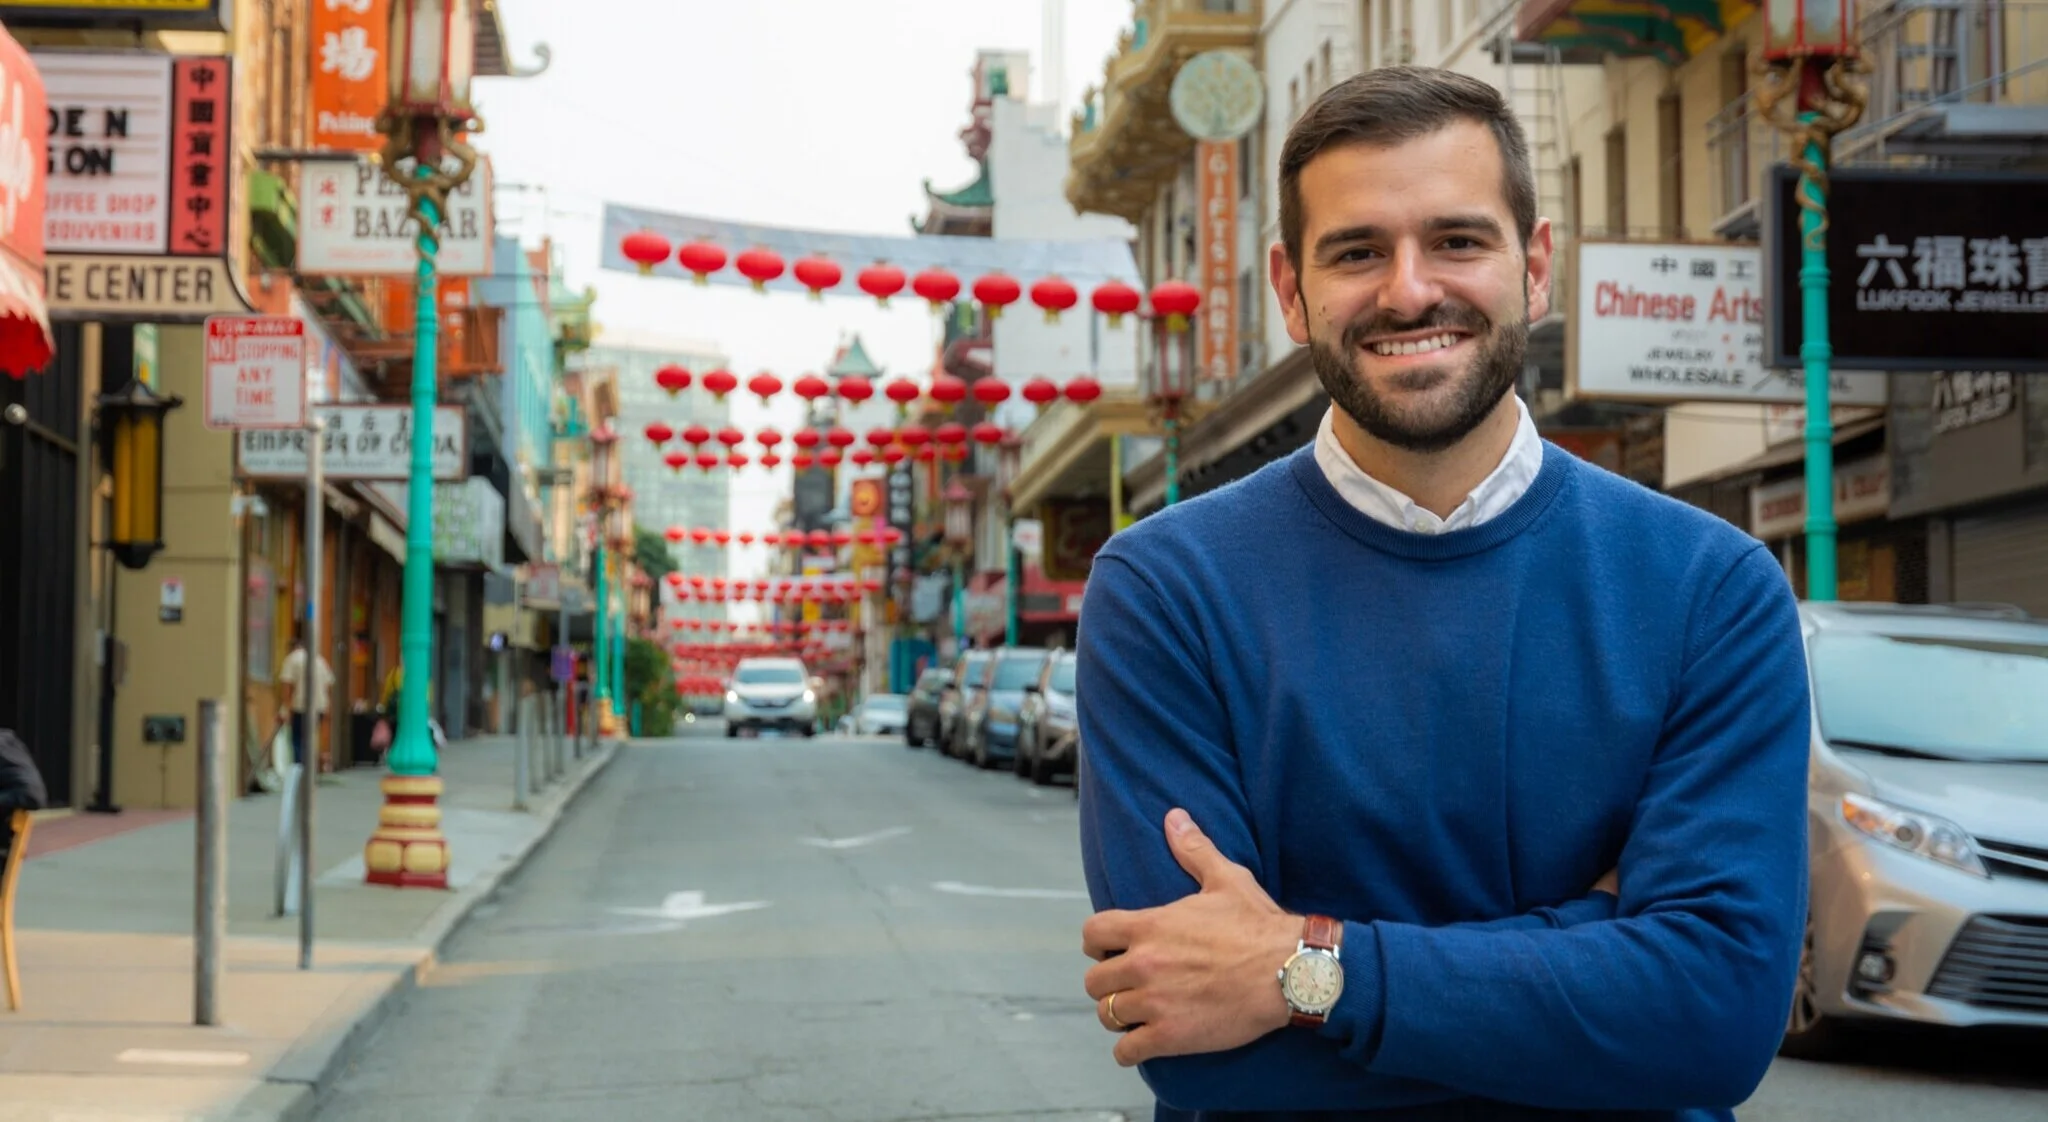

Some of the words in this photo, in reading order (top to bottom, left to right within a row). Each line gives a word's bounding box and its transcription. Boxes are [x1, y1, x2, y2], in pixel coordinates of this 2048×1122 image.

[321, 0, 378, 81] 場
[107, 192, 157, 214] SHOP
[49, 219, 157, 242] SOUVENIRS
[354, 206, 478, 239] BAZAR
[86, 266, 213, 303] CENTER
[1594, 280, 1697, 322] Chinese
[1708, 286, 1764, 323] Arts
[216, 320, 297, 336] TOW-AWAY
[210, 338, 234, 360] NO
[238, 342, 297, 360] STOPPING
[238, 366, 273, 382] ANY
[1629, 365, 1745, 387] WHOLESALE
[236, 387, 274, 405] TIME
